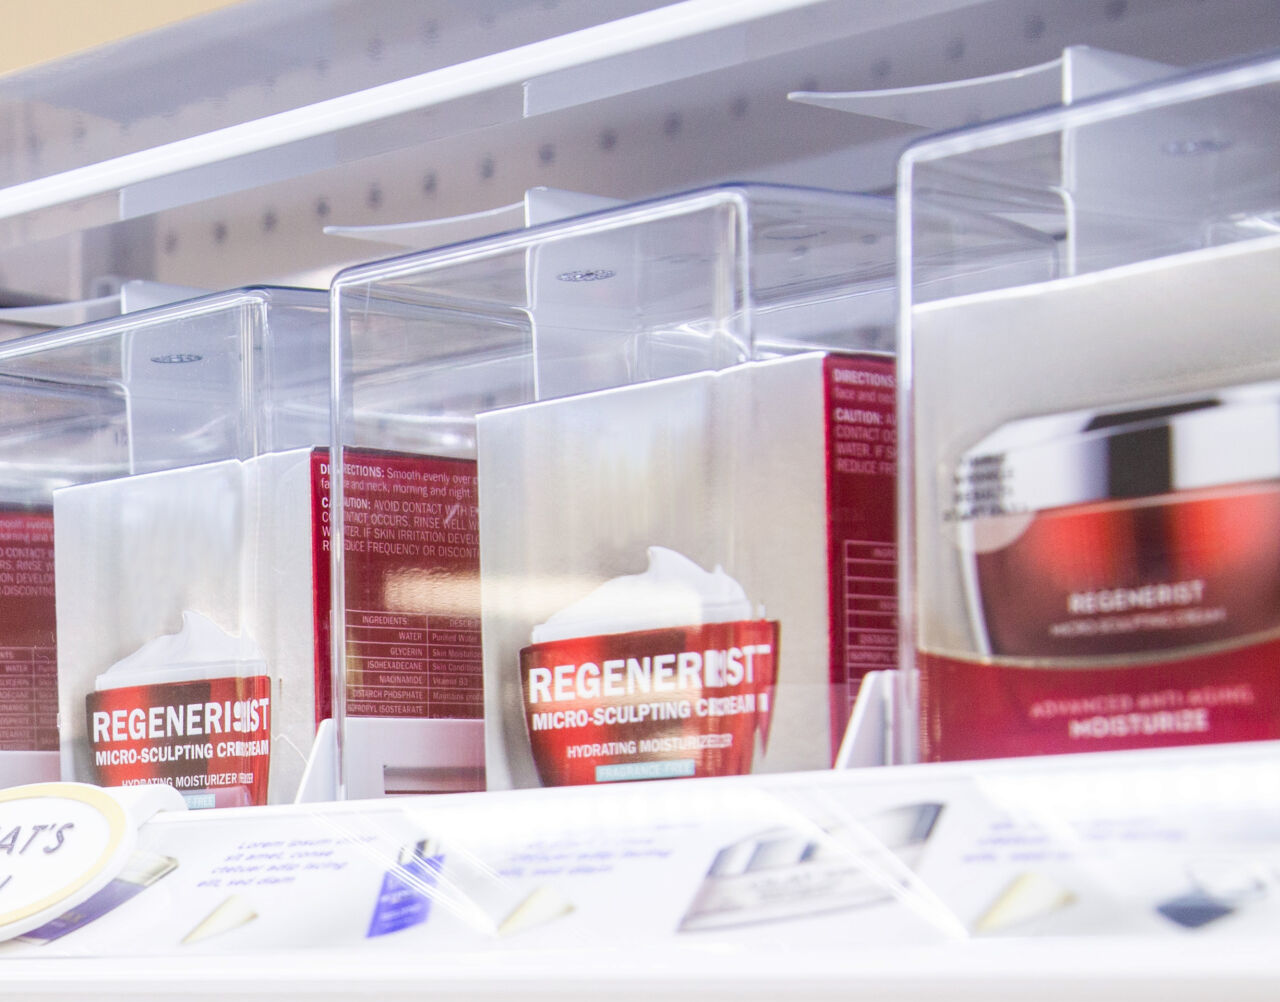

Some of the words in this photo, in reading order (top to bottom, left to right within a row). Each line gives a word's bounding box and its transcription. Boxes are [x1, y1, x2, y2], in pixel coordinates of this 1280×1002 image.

[387, 467, 420, 481] Smooth
[423, 474, 450, 486] evenly
[452, 476, 470, 485] over
[393, 484, 428, 497] morning
[430, 486, 447, 497] and
[449, 487, 472, 500] night.
[374, 500, 400, 512] AVOID
[402, 501, 442, 514] CONTACT
[413, 516, 440, 529] RINSE
[374, 528, 396, 539] SKIN
[398, 529, 446, 543] IRRITATION
[367, 541, 420, 556] FREQUENCY
[1068, 578, 1205, 615] REGENERIST
[362, 615, 408, 625] INGREDIENTS
[398, 631, 423, 641] WATER
[390, 647, 423, 656] GLYCERIN
[367, 660, 423, 670] ISOHEXADECANE
[528, 644, 768, 704] REGENERIST
[532, 702, 691, 731] MICRO-SCULPTING
[695, 693, 758, 717] CREAM
[93, 698, 269, 743] REGENERIST
[1070, 707, 1208, 739] MOISTURIZE
[566, 741, 637, 759] HYDRATING
[639, 733, 733, 753] MOISTURIZER
[96, 743, 213, 766] MICRO-SCULPTING
[175, 773, 240, 789] MOISTURIZER
